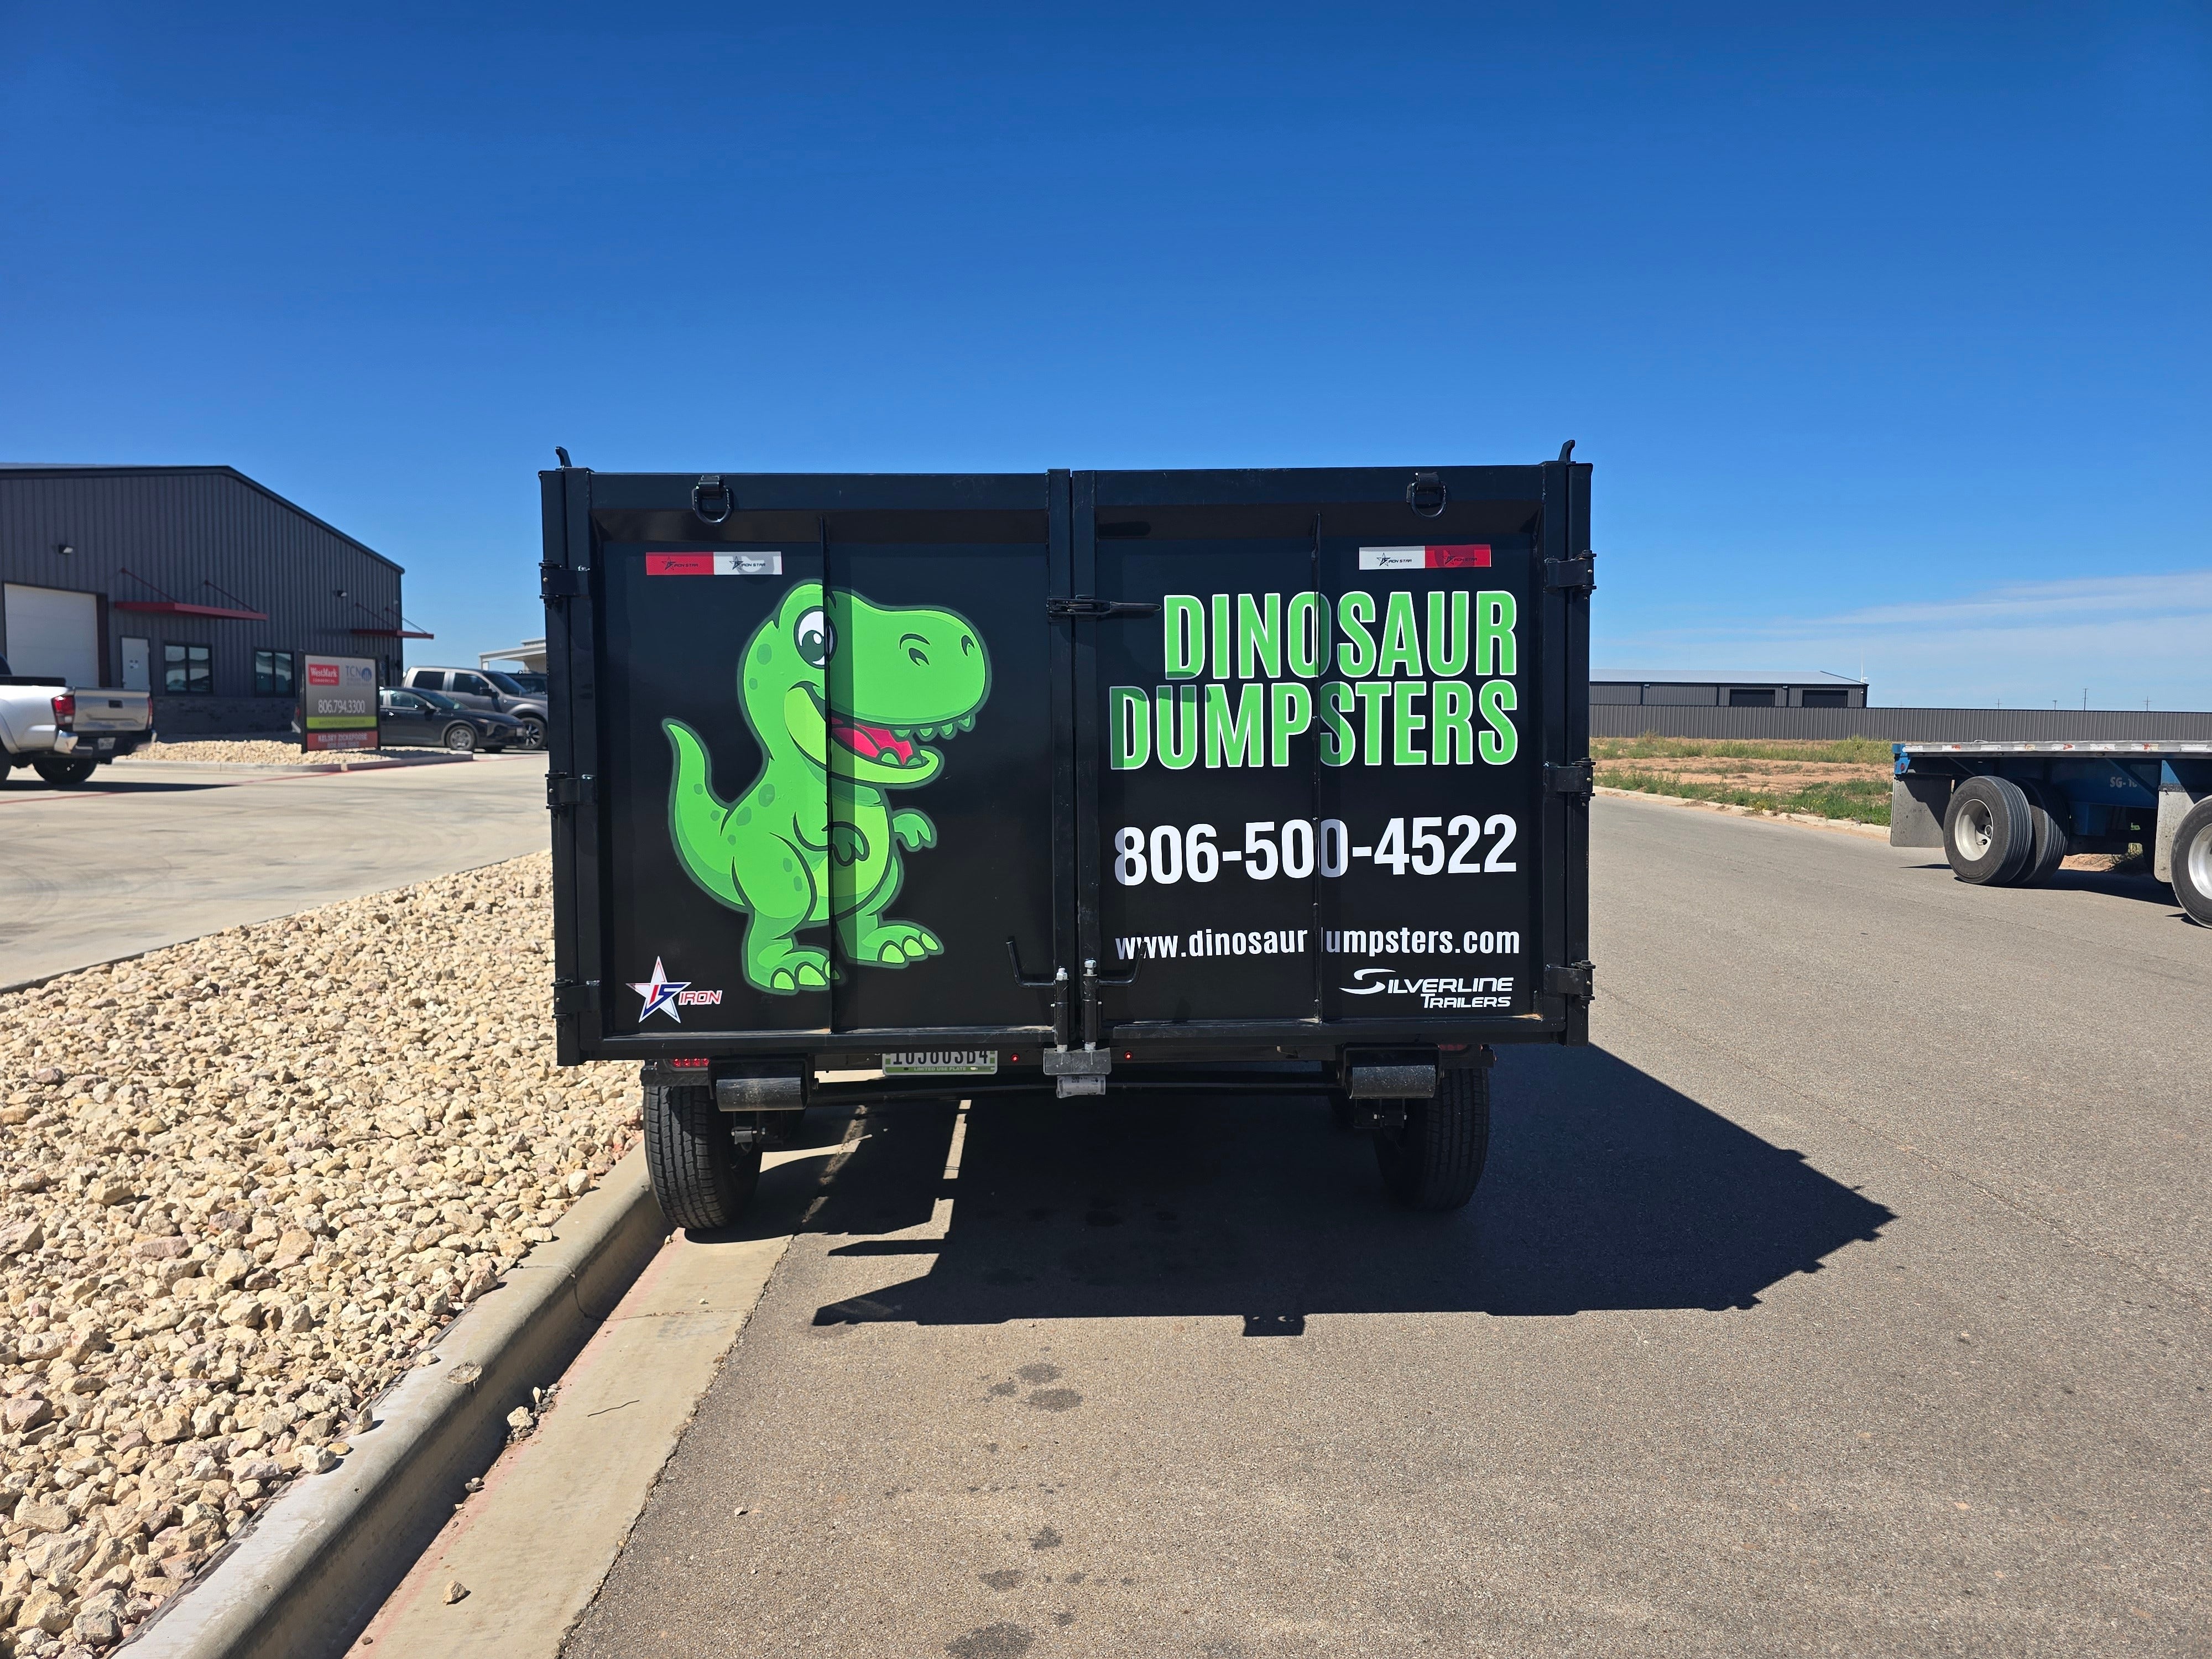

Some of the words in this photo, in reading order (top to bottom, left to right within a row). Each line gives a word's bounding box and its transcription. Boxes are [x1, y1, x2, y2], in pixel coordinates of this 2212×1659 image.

[1164, 591, 1517, 680] DINOSAUR
[345, 665, 361, 677] TCN
[318, 699, 366, 713] 806.794.3300
[1109, 680, 1518, 770] DUMPSTERS
[1114, 814, 1517, 886] 806-500-4522
[1115, 927, 1520, 960] www.dinosaurumpsters.com
[1339, 968, 1514, 994] SILVERLINE
[679, 990, 722, 1005] IRON
[1420, 993, 1511, 1009] TRAILERS
